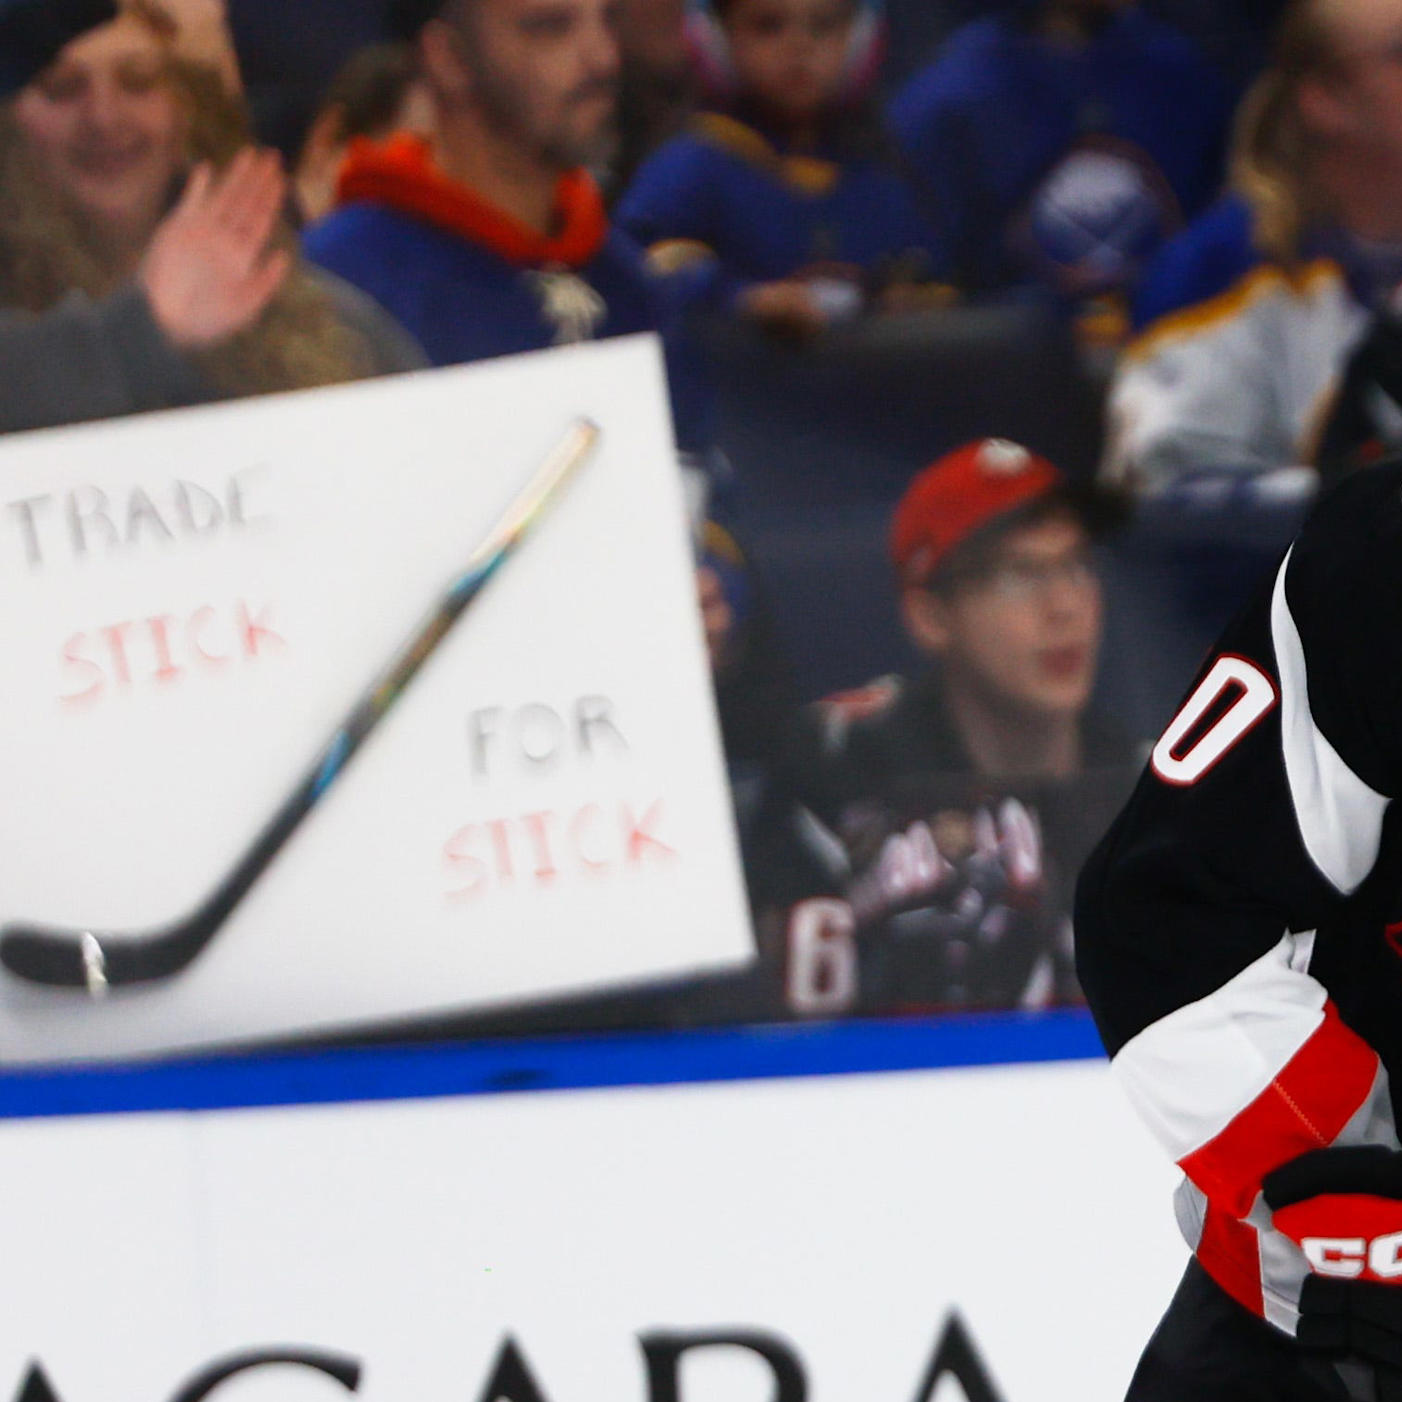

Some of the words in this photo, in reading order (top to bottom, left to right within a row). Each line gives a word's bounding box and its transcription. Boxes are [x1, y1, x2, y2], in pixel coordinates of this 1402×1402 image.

[6, 462, 272, 568] TRADE
[58, 600, 288, 710] STICK
[466, 692, 630, 782] FOR
[440, 797, 682, 910] STICK
[787, 895, 857, 1014] 6
